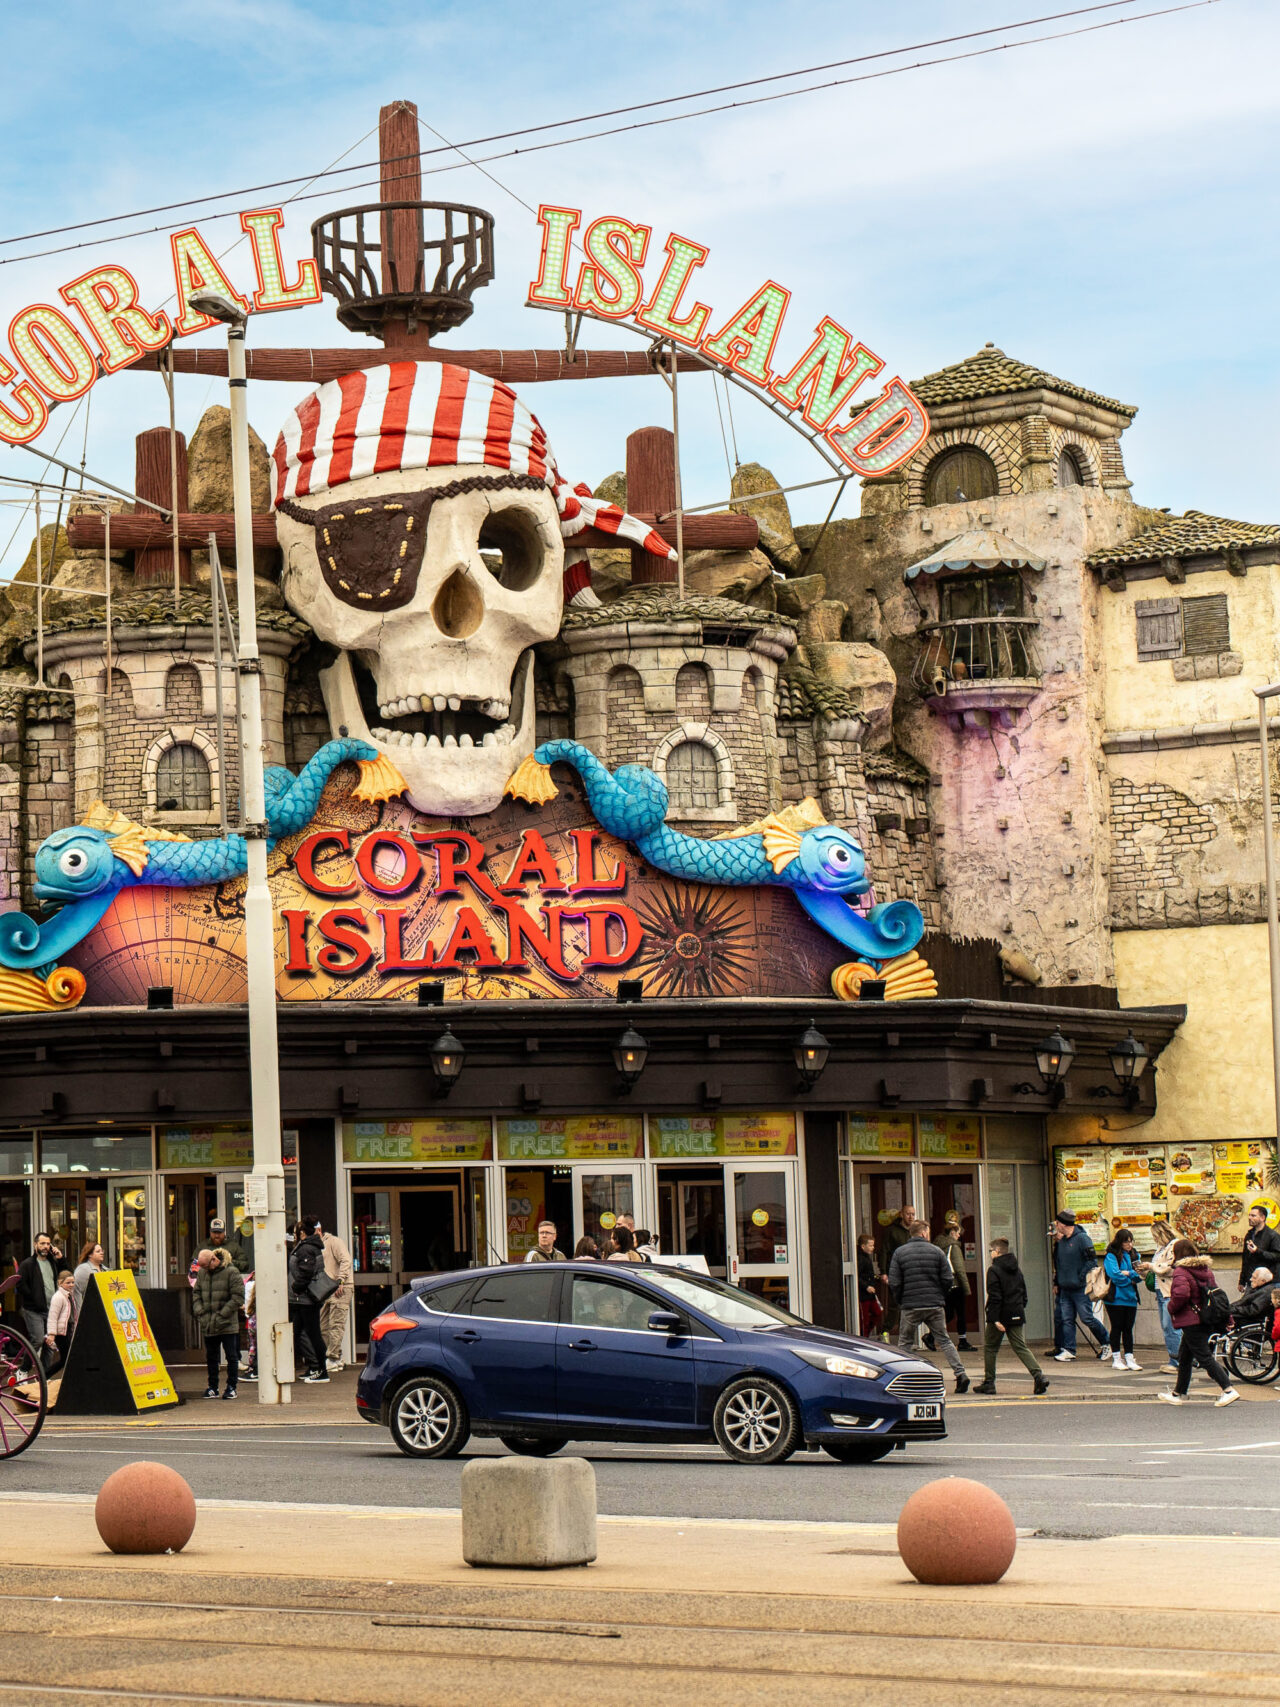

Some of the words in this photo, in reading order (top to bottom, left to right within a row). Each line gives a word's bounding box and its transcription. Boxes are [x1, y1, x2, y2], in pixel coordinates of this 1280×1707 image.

[528, 204, 931, 477] ISLAND
[293, 829, 625, 903] CORAL
[281, 900, 644, 980] ISLAND
[355, 1122, 384, 1135] KIDS
[388, 1121, 413, 1135] EAT
[540, 1120, 566, 1132] EAT
[356, 1137, 412, 1157] FREE
[509, 1135, 565, 1155] FREE
[662, 1133, 716, 1153] FREE
[853, 1132, 879, 1151] FREE
[922, 1135, 947, 1153] FREE
[167, 1143, 213, 1163] FREE
[508, 1199, 532, 1215] DS
[508, 1216, 529, 1232] AT
[508, 1234, 535, 1249] EE
[113, 1299, 138, 1321] KIDS
[121, 1321, 142, 1341] EAT
[125, 1341, 152, 1361] FREE
